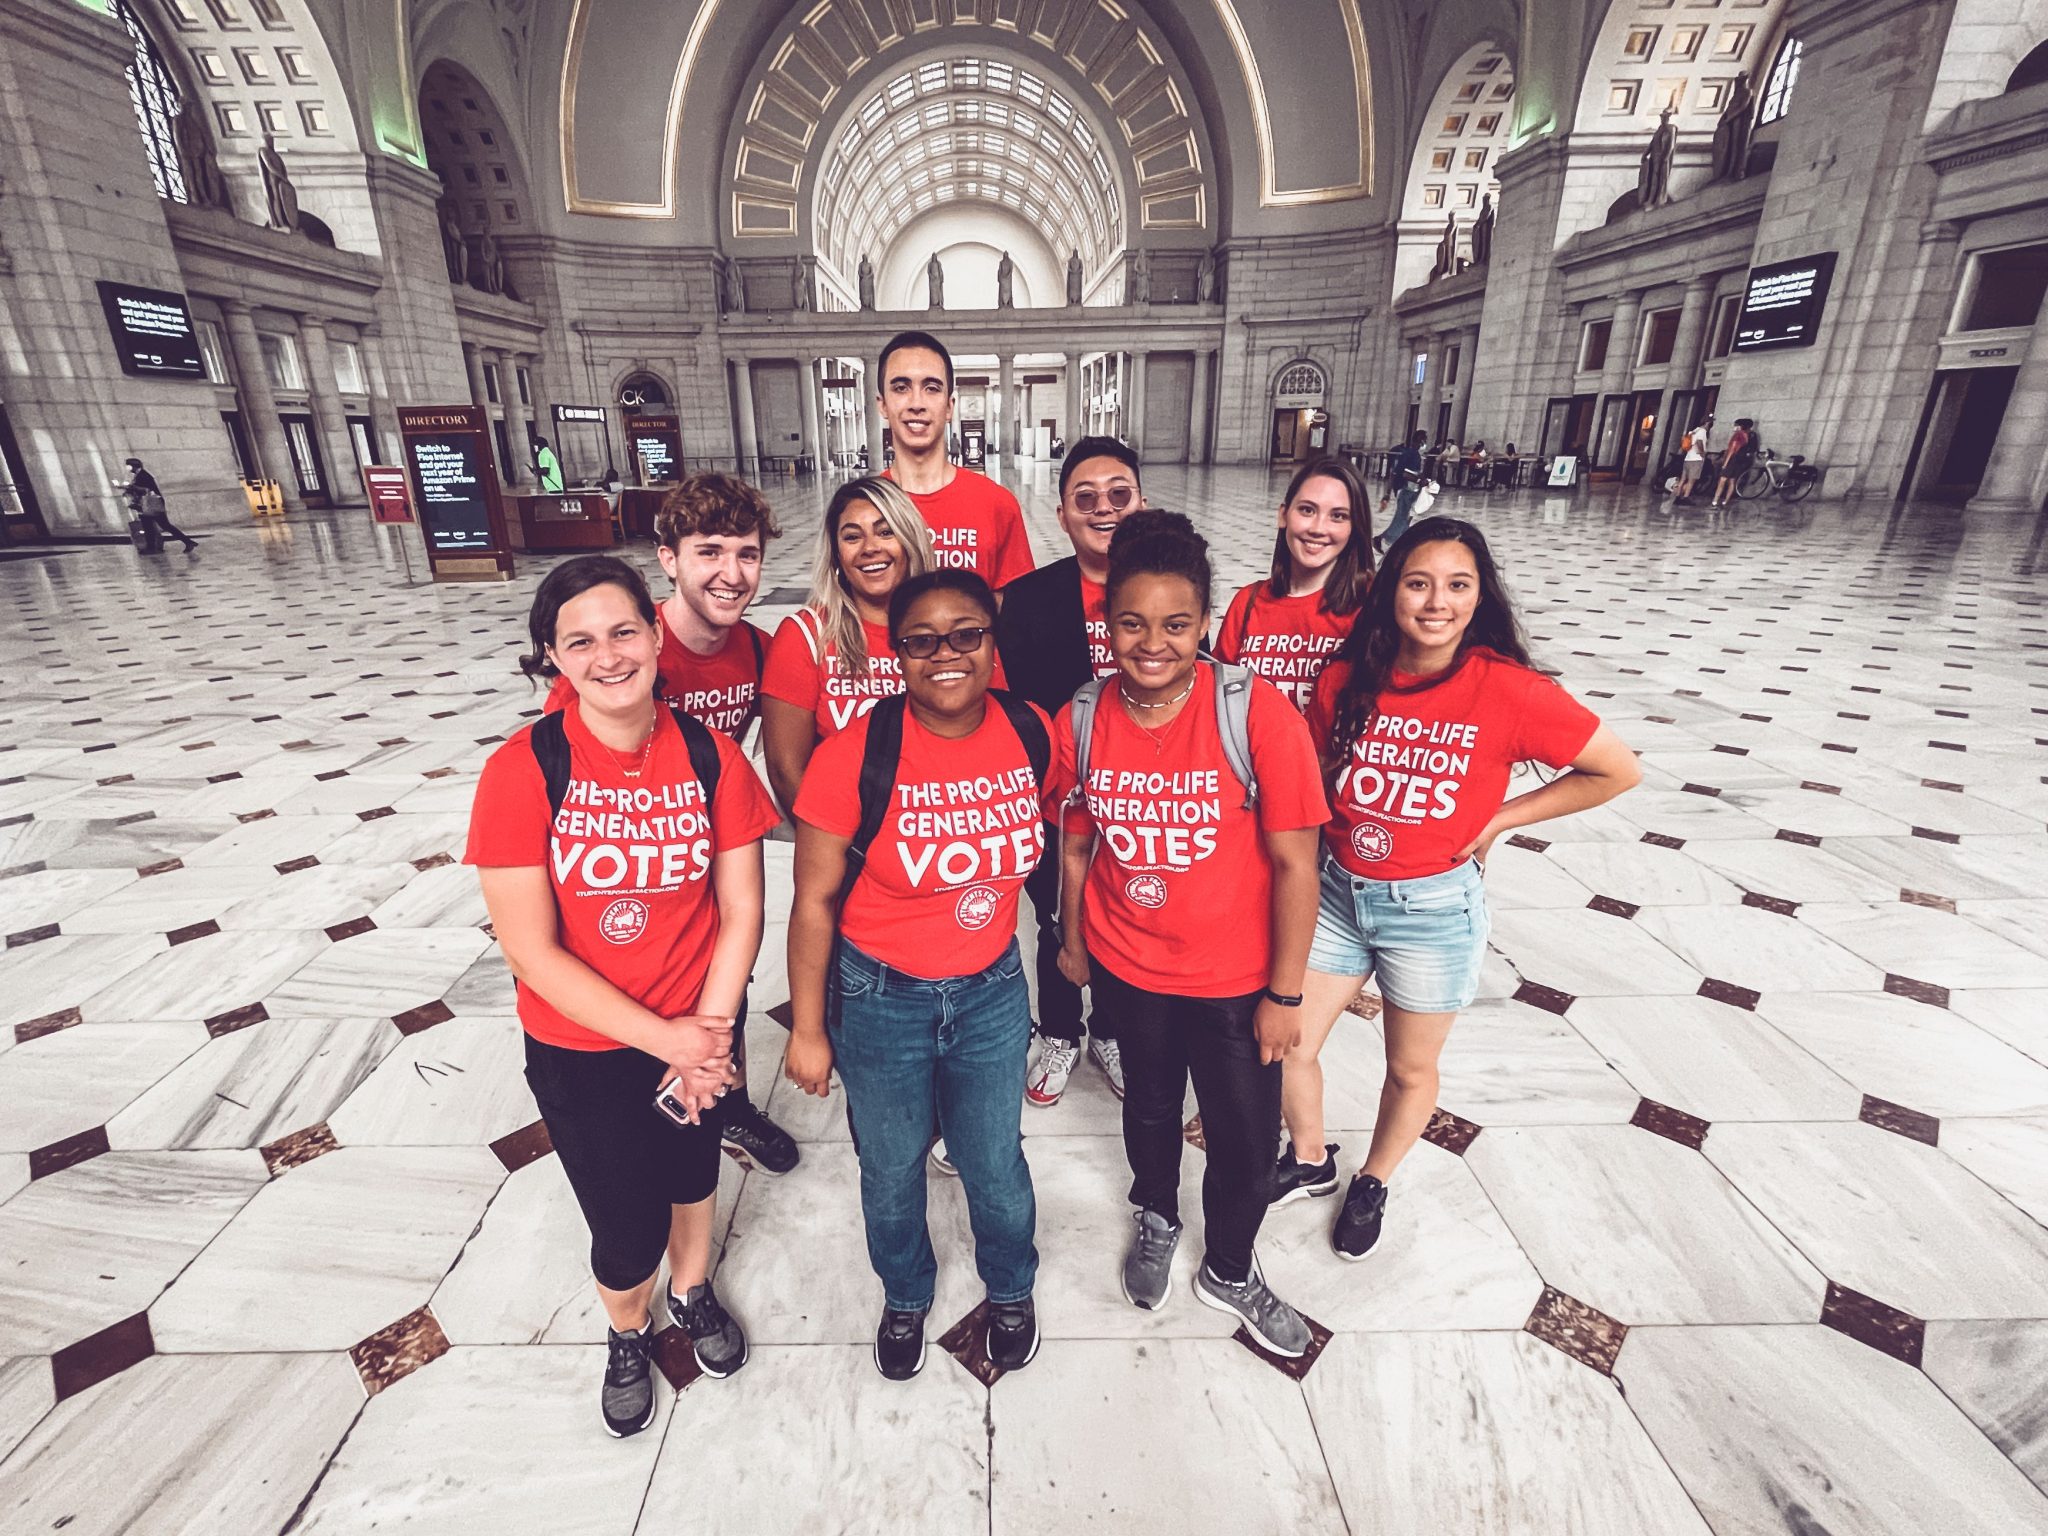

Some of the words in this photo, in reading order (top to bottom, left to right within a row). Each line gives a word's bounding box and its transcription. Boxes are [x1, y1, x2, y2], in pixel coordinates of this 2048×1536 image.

[404, 415, 468, 425] DIRECTORY
[415, 444, 442, 452] Switch
[442, 444, 450, 452] to
[434, 452, 464, 460] Internet
[434, 461, 446, 469] get
[447, 461, 464, 469] your
[438, 469, 454, 477] year
[454, 468, 462, 476] of
[453, 476, 476, 484] Prime
[934, 550, 977, 568] TION
[1086, 621, 1110, 639] PR
[1240, 636, 1264, 653] HE
[1266, 634, 1345, 653] PRO-LIFE
[1238, 657, 1322, 677] ENERATIO
[684, 682, 754, 712] PRO-LIFE
[826, 678, 906, 696] GENERA
[692, 707, 748, 730] ATIO
[1374, 715, 1479, 748] PRO-LIFE
[1343, 740, 1470, 776] NERATION
[898, 782, 945, 808] THE
[945, 766, 1036, 805] PRO-LIFE
[1088, 769, 1114, 792] HE
[1117, 770, 1219, 794] PRO-LIFE
[602, 780, 707, 812] PRO-LIFE
[554, 808, 710, 840] GENERATION
[898, 793, 1040, 837] GENERATION
[550, 836, 710, 888] VOTES
[896, 821, 1045, 888] VOTES
